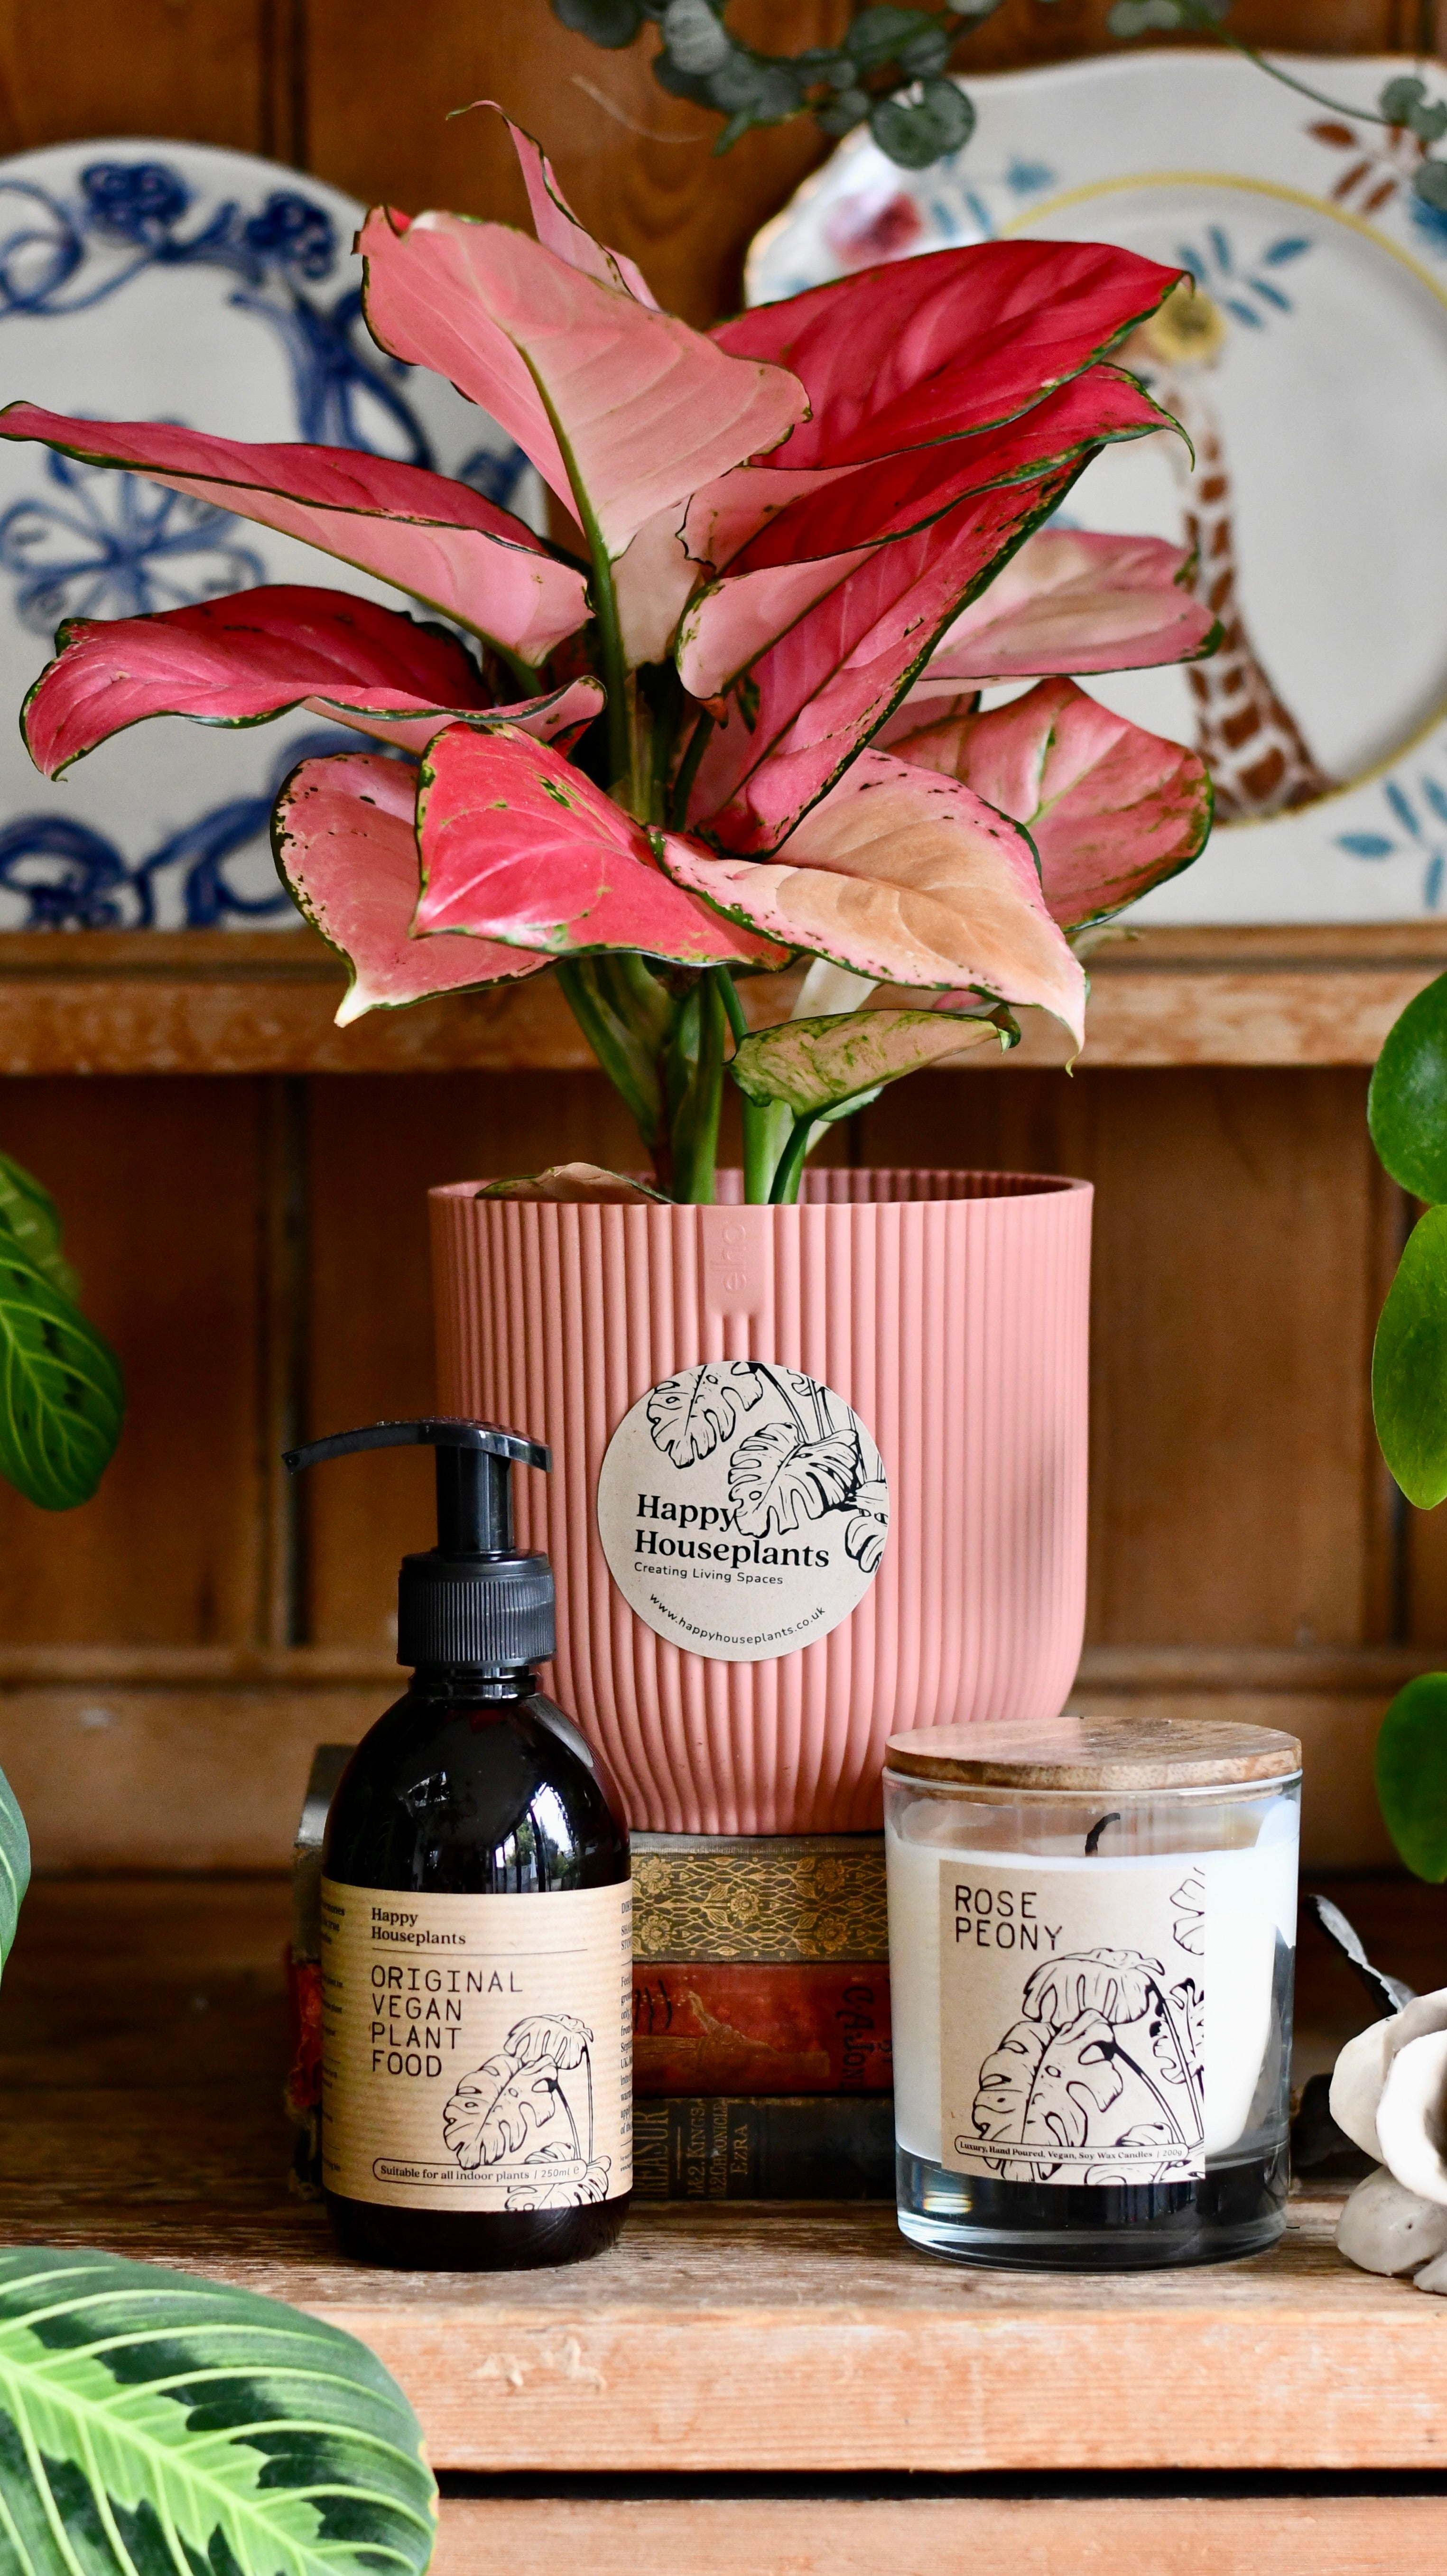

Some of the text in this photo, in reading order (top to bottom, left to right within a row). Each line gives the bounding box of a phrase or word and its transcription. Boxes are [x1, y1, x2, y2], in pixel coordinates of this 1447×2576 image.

[636, 1493, 737, 1532] Happy
[634, 1529, 829, 1568] Houseplants
[634, 1561, 783, 1585] Creating Living Spaces
[650, 1594, 826, 1645] www.happyhouseplants.co.uk
[955, 1885, 1037, 1918] ROSE
[371, 1907, 418, 1927] Happy
[371, 1927, 466, 1946] Houseplants
[955, 1917, 1062, 1951] PEONY
[371, 1964, 523, 1993] ORIGINAL
[372, 1993, 461, 2021] VEGAN
[371, 2022, 462, 2049] PLANT
[372, 2050, 442, 2077] FOOD
[730, 2124, 748, 2175] EZRA
[960, 2141, 988, 2153] Luxury,
[989, 2146, 1011, 2155] Hand
[1012, 2148, 1046, 2158] Poured,
[1048, 2151, 1076, 2160] Vegan,
[380, 2165, 420, 2178] Suitable
[422, 2169, 439, 2179] for
[441, 2171, 453, 2179] all
[456, 2170, 493, 2180] indoor
[496, 2171, 529, 2183] plants
[541, 2168, 570, 2178] 250ml
